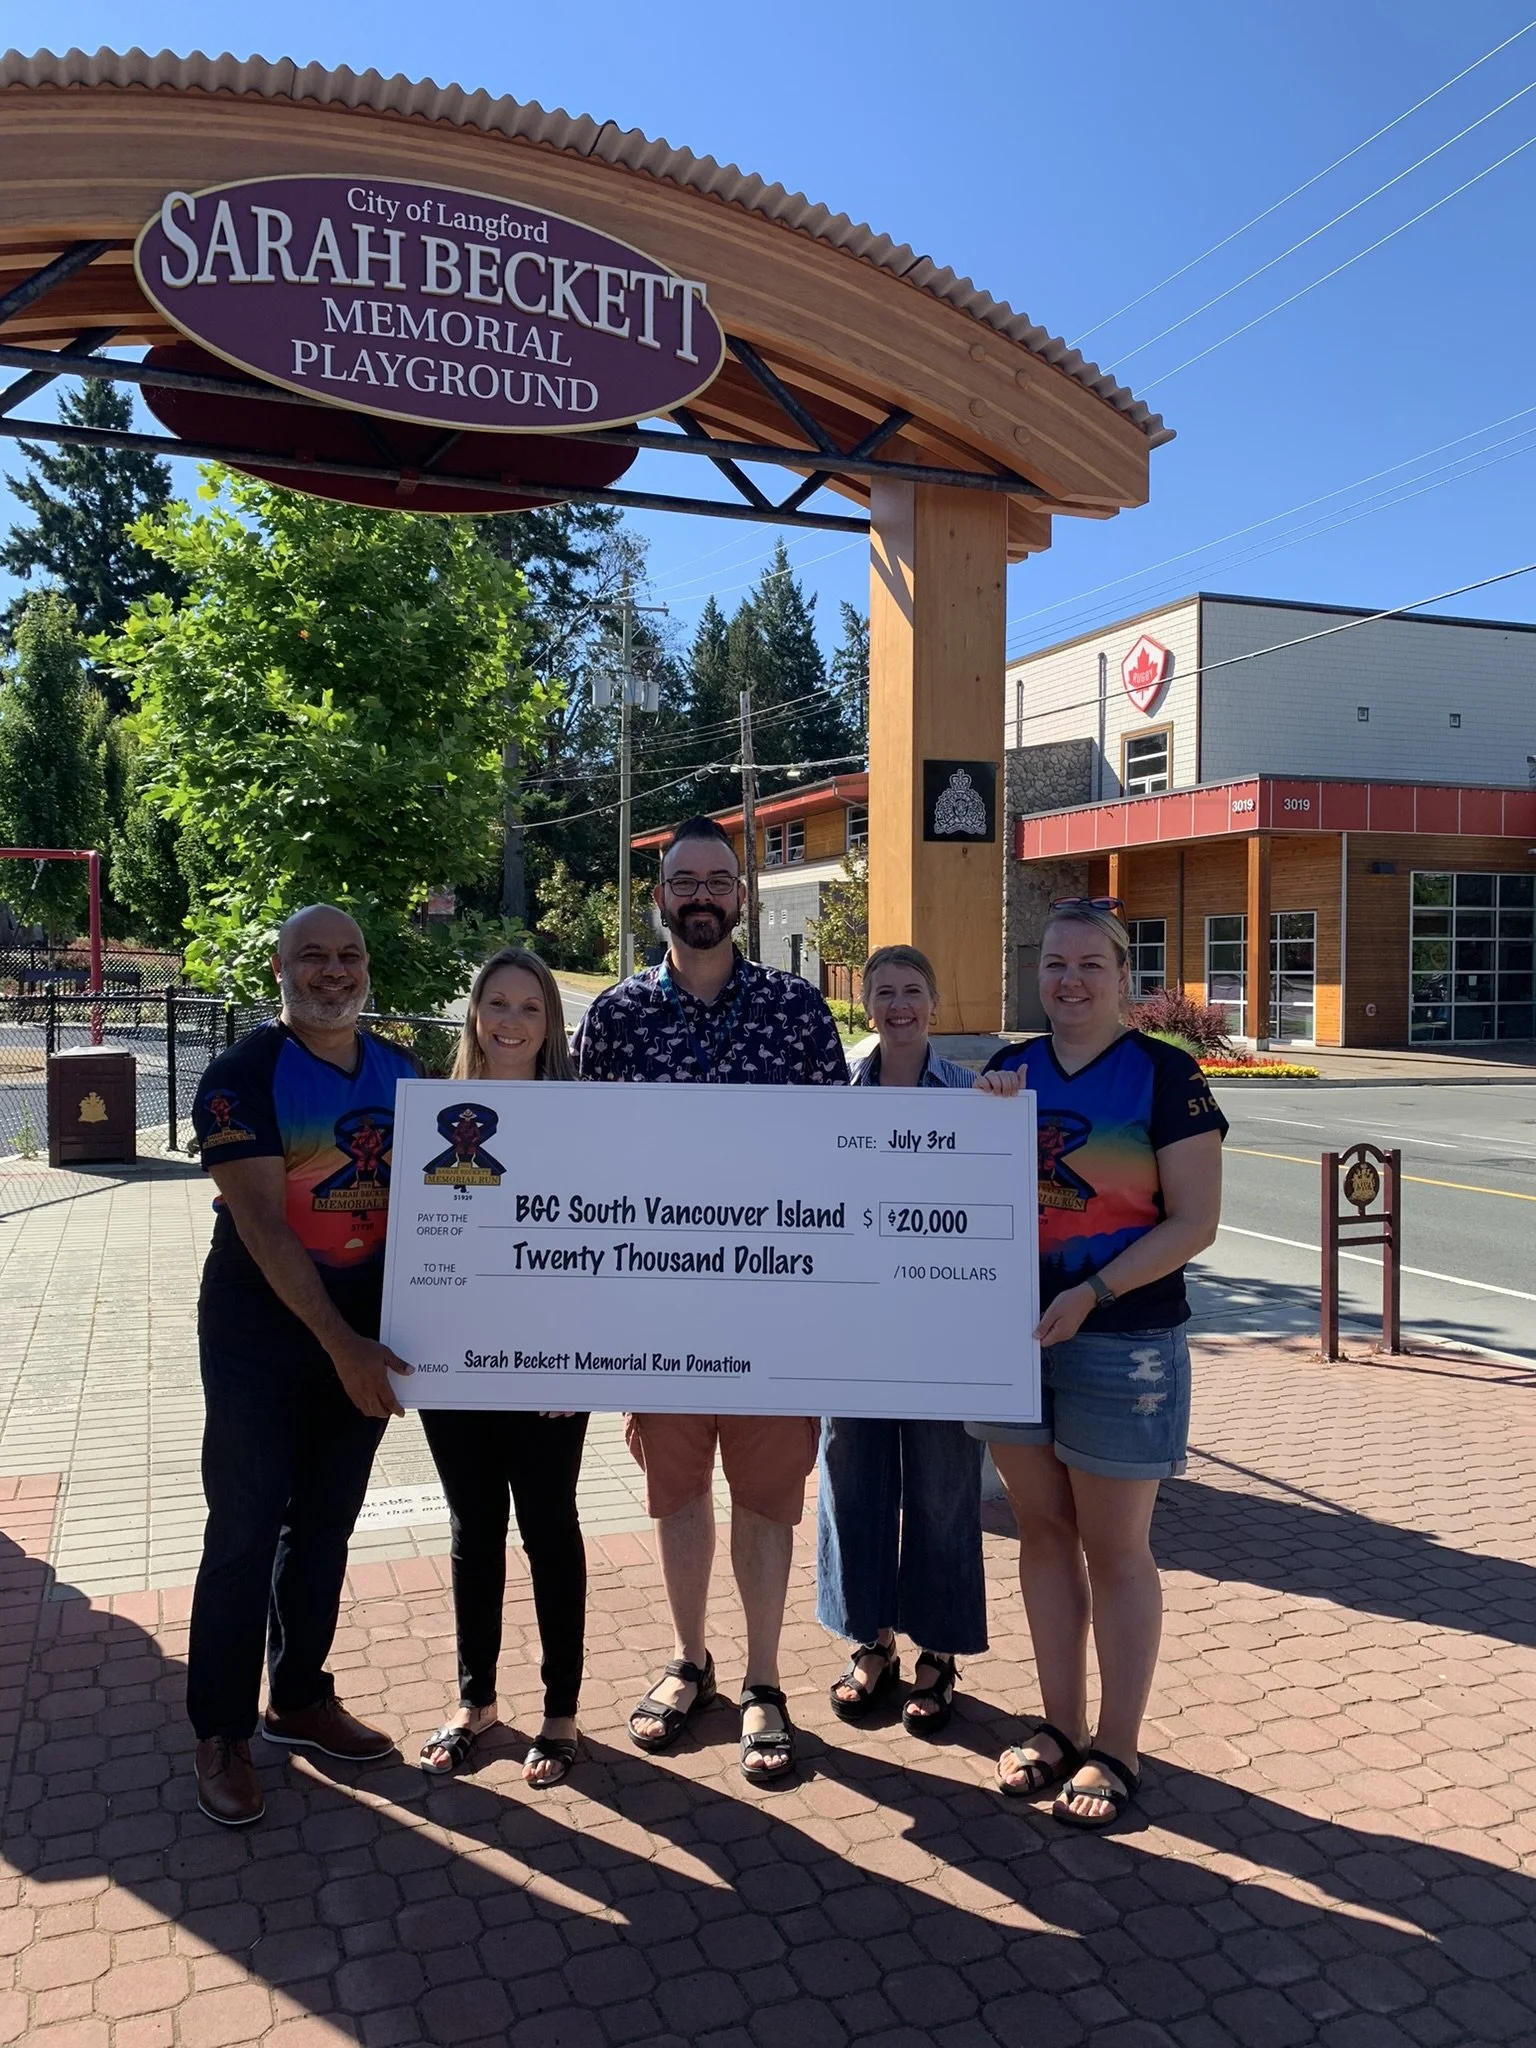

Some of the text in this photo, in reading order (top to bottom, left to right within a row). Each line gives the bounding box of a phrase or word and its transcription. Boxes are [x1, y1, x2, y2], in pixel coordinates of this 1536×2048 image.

[347, 187, 550, 244] City of Langford
[160, 191, 707, 364] SARAH BECKETT
[321, 297, 574, 367] MEMORIAL
[291, 339, 599, 413] PLAYGROUND
[1231, 798, 1253, 813] 3019
[1284, 798, 1310, 811] 3019
[837, 1129, 956, 1152] DATE: July 3rd
[427, 1175, 498, 1184] MEMORIAL RUN
[331, 1190, 359, 1199] SARAH
[317, 1199, 381, 1209] MEMORIAL
[515, 1194, 846, 1229] BGC South Vancouver Island
[417, 1213, 468, 1224] PAY TO THE
[863, 1208, 968, 1236] $ $20,000
[417, 1226, 463, 1236] ORDER OF
[513, 1241, 814, 1276] Twenty Thousand Dollars
[424, 1263, 456, 1273] TO THE
[893, 1265, 997, 1281] /100 DOLLARS
[410, 1276, 467, 1286] AMOUNT OF
[418, 1363, 449, 1373] MEMO
[464, 1350, 751, 1373] Sarah Beckett Memorial Run Donation
